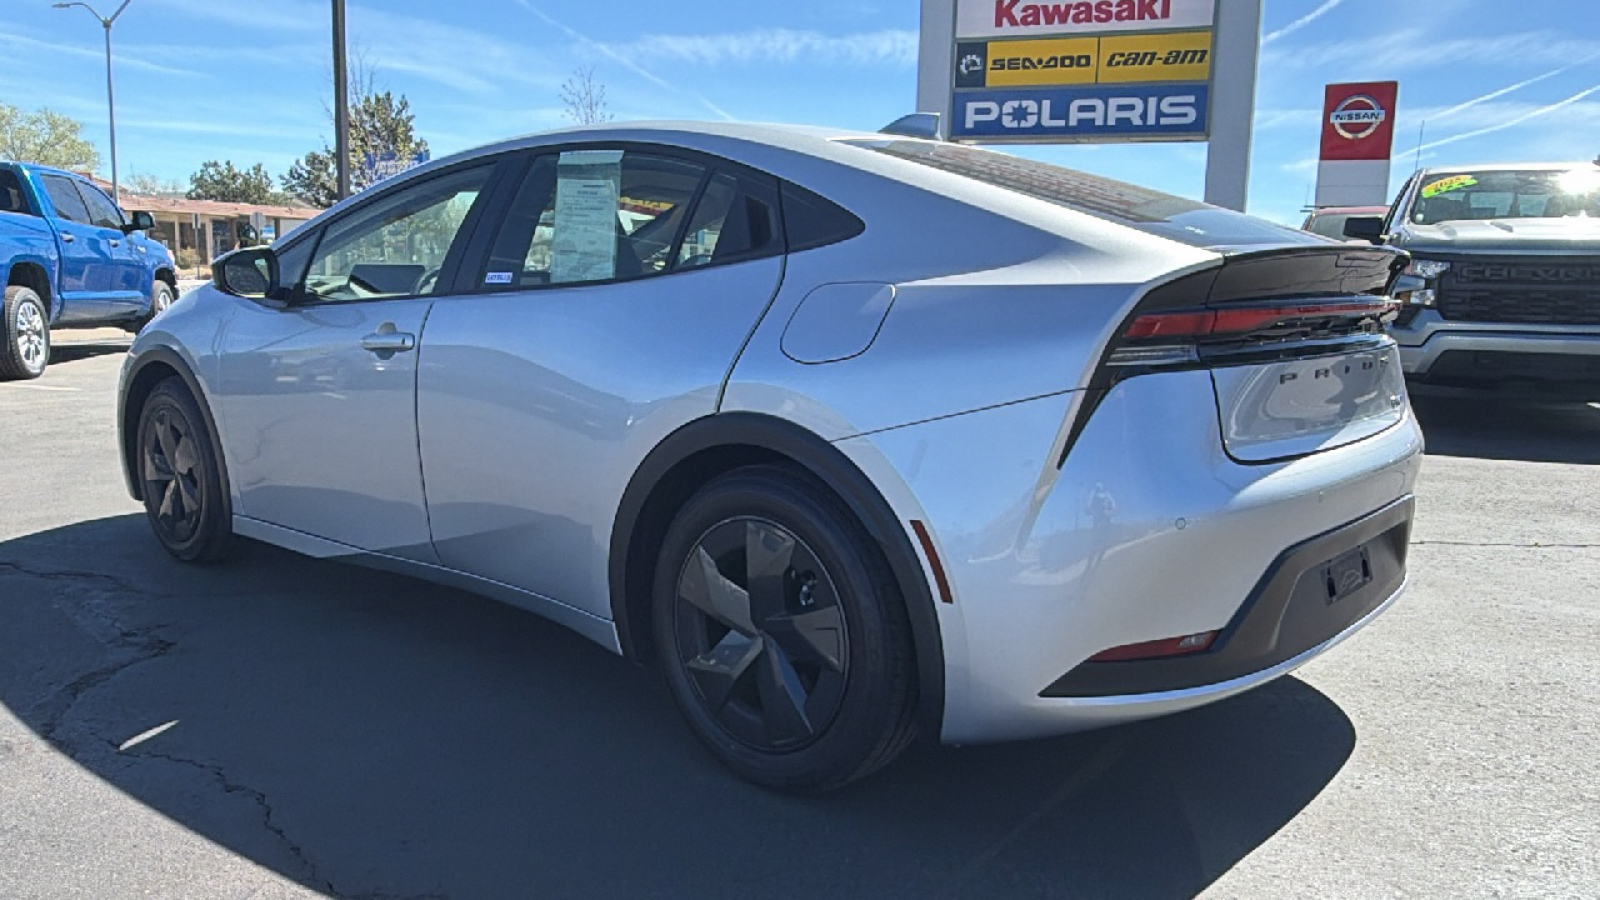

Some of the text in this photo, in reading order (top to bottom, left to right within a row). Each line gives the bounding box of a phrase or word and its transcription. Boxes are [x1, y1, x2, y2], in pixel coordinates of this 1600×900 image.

[994, 0, 1171, 28] Kawasaki
[1105, 49, 1208, 68] can-am
[964, 94, 1197, 129] POLARIS
[1334, 111, 1380, 121] NISSAN
